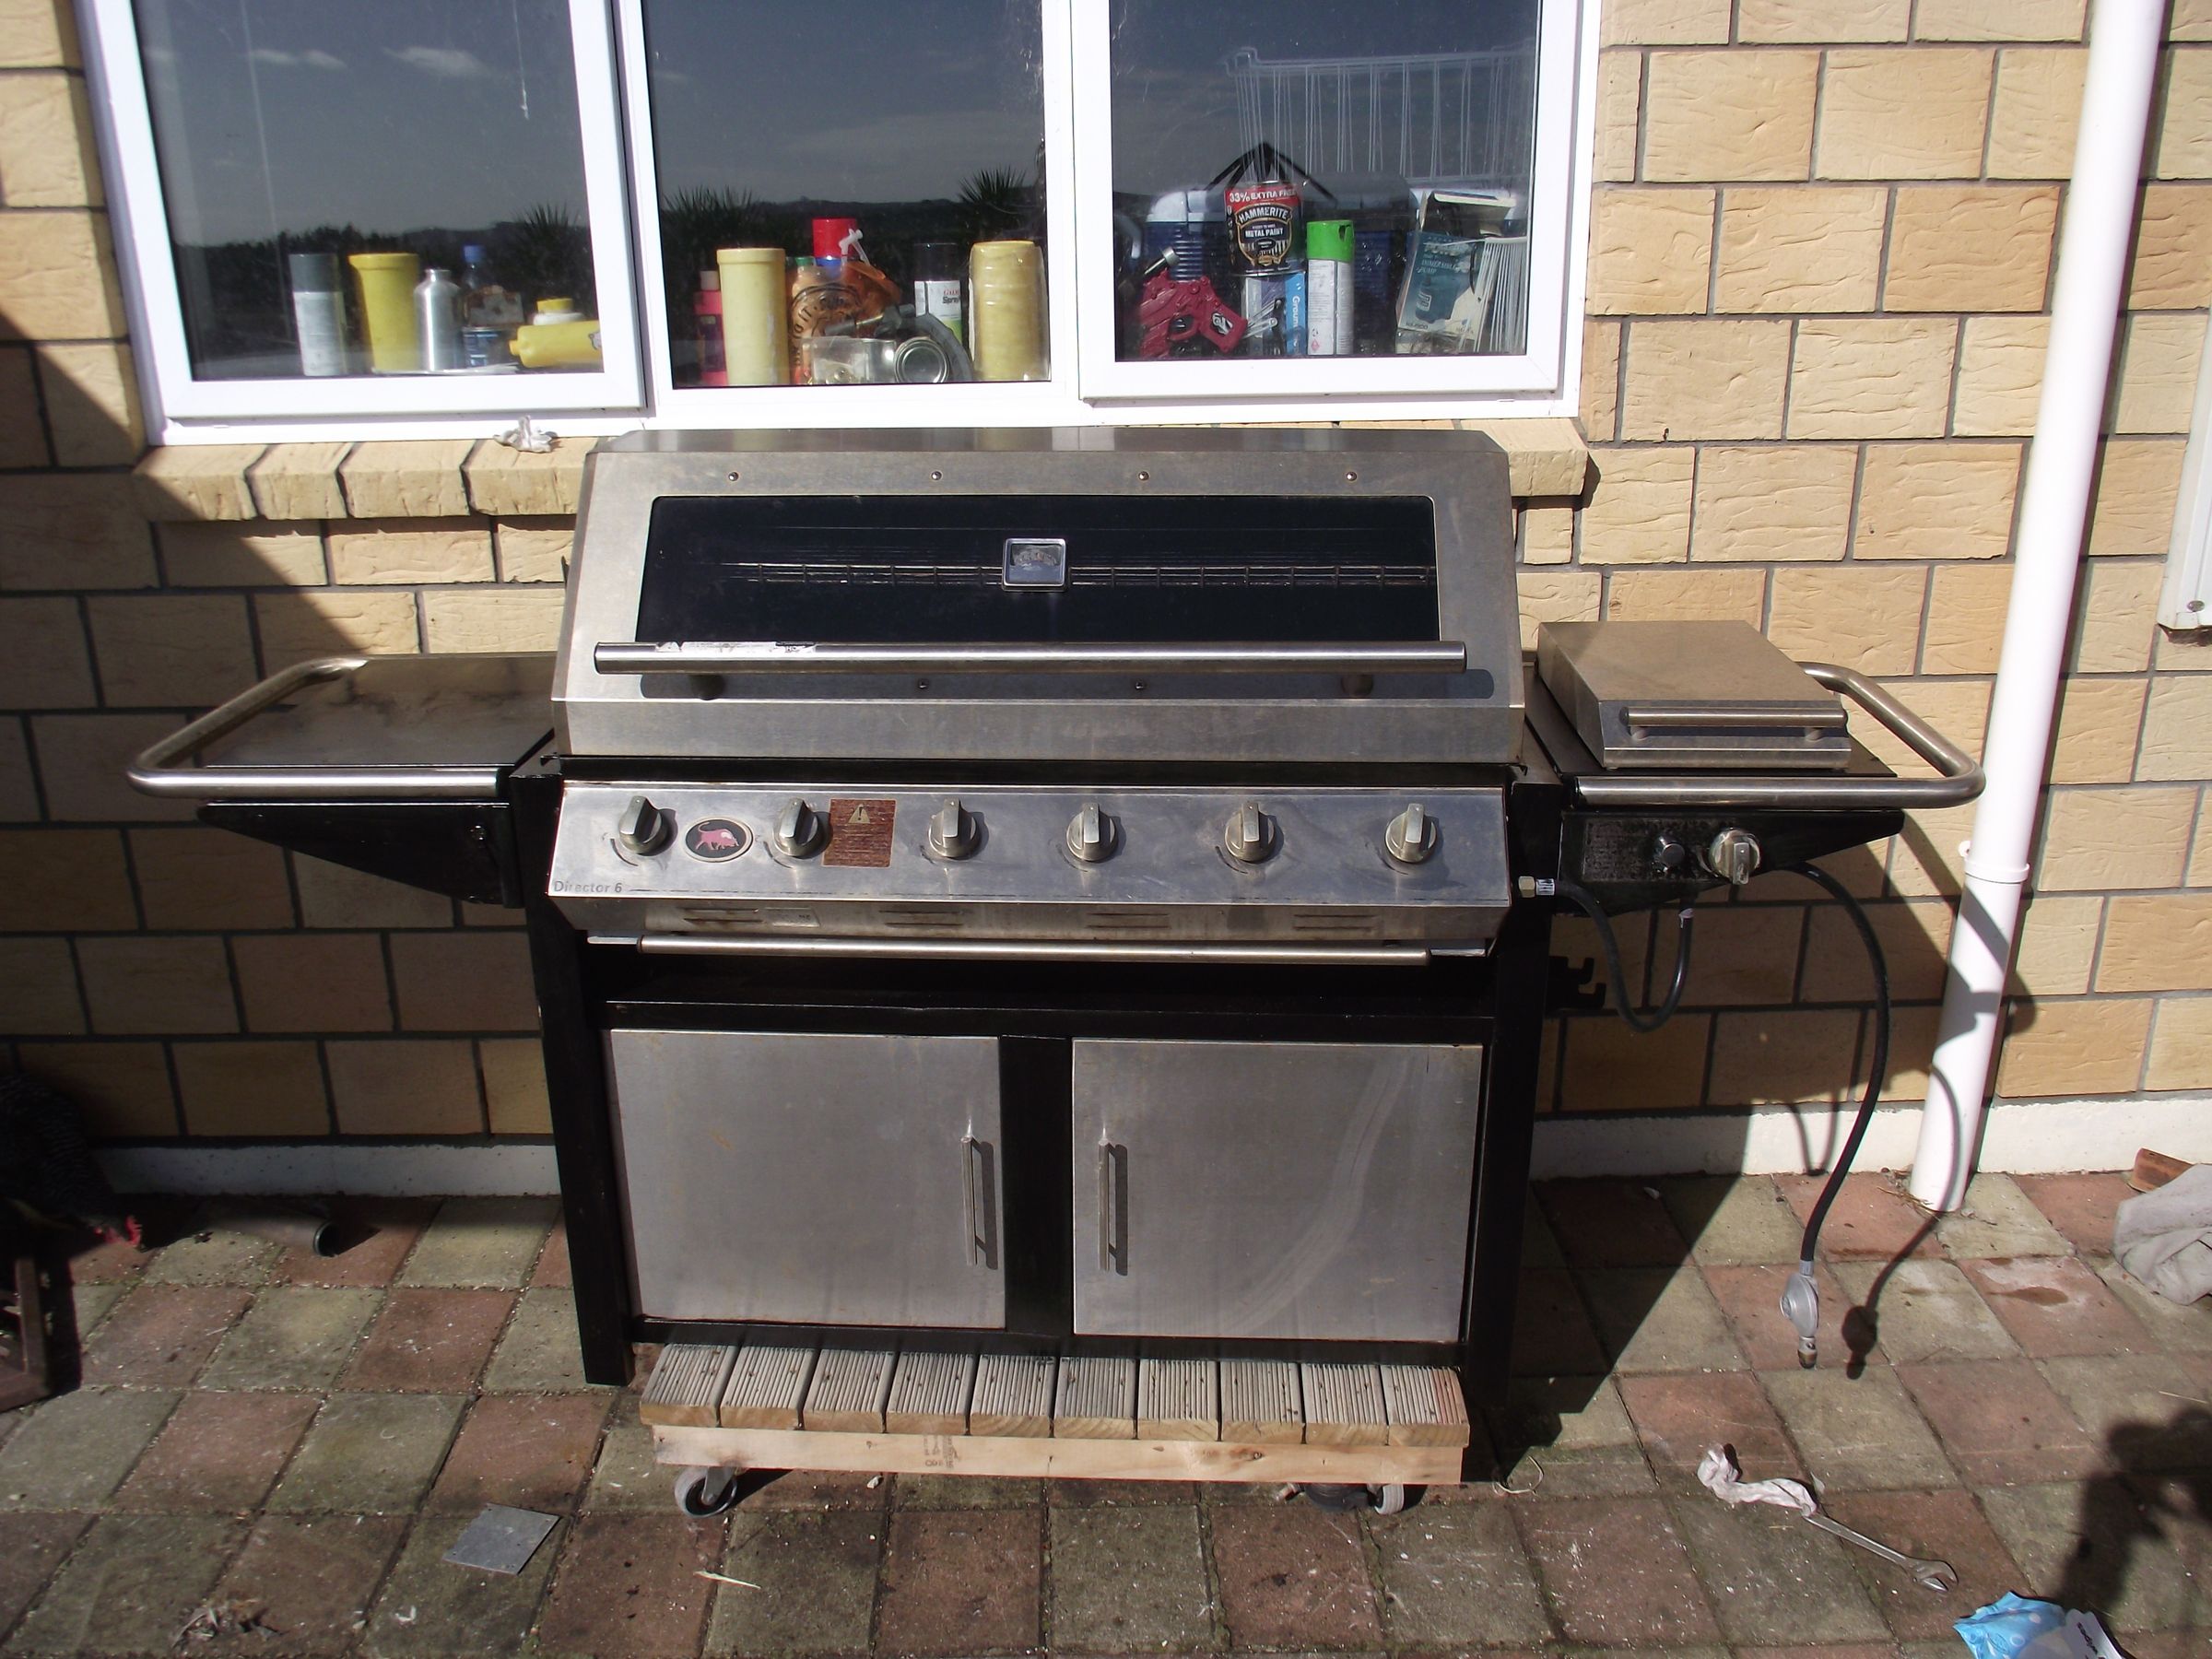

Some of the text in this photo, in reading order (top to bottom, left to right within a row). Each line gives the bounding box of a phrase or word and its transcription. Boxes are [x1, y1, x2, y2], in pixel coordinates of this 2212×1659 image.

[1230, 192, 1251, 203] 33%
[1251, 190, 1278, 200] EXTRA
[1238, 206, 1288, 223] HAMMERITE
[1245, 228, 1284, 238] METAL PAINT
[554, 880, 623, 893] Director 6
